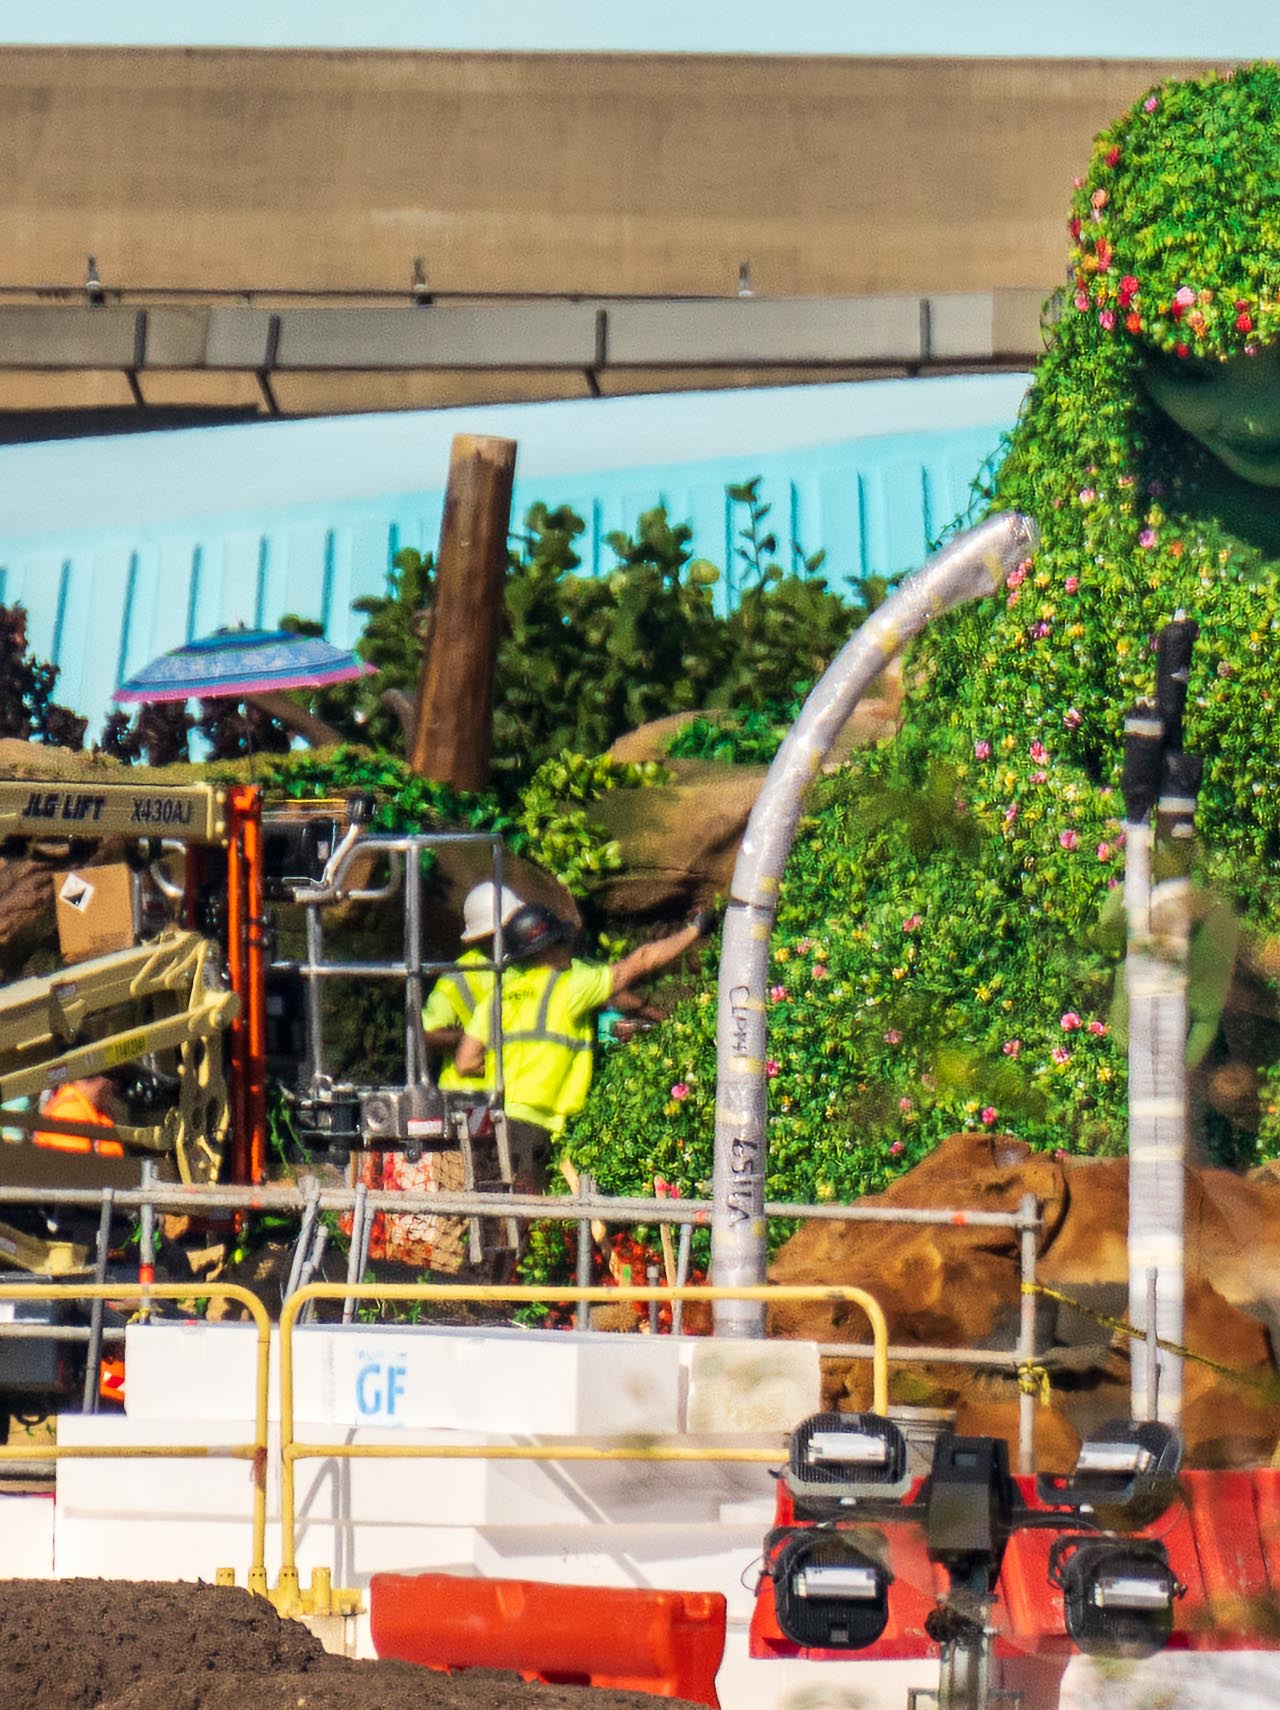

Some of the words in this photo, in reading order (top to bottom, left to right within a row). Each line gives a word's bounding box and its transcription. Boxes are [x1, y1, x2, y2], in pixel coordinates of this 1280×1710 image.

[22, 792, 59, 817] JLG
[62, 794, 106, 820] LIFT
[130, 798, 192, 824] X430AJ
[356, 1364, 407, 1416] GF
